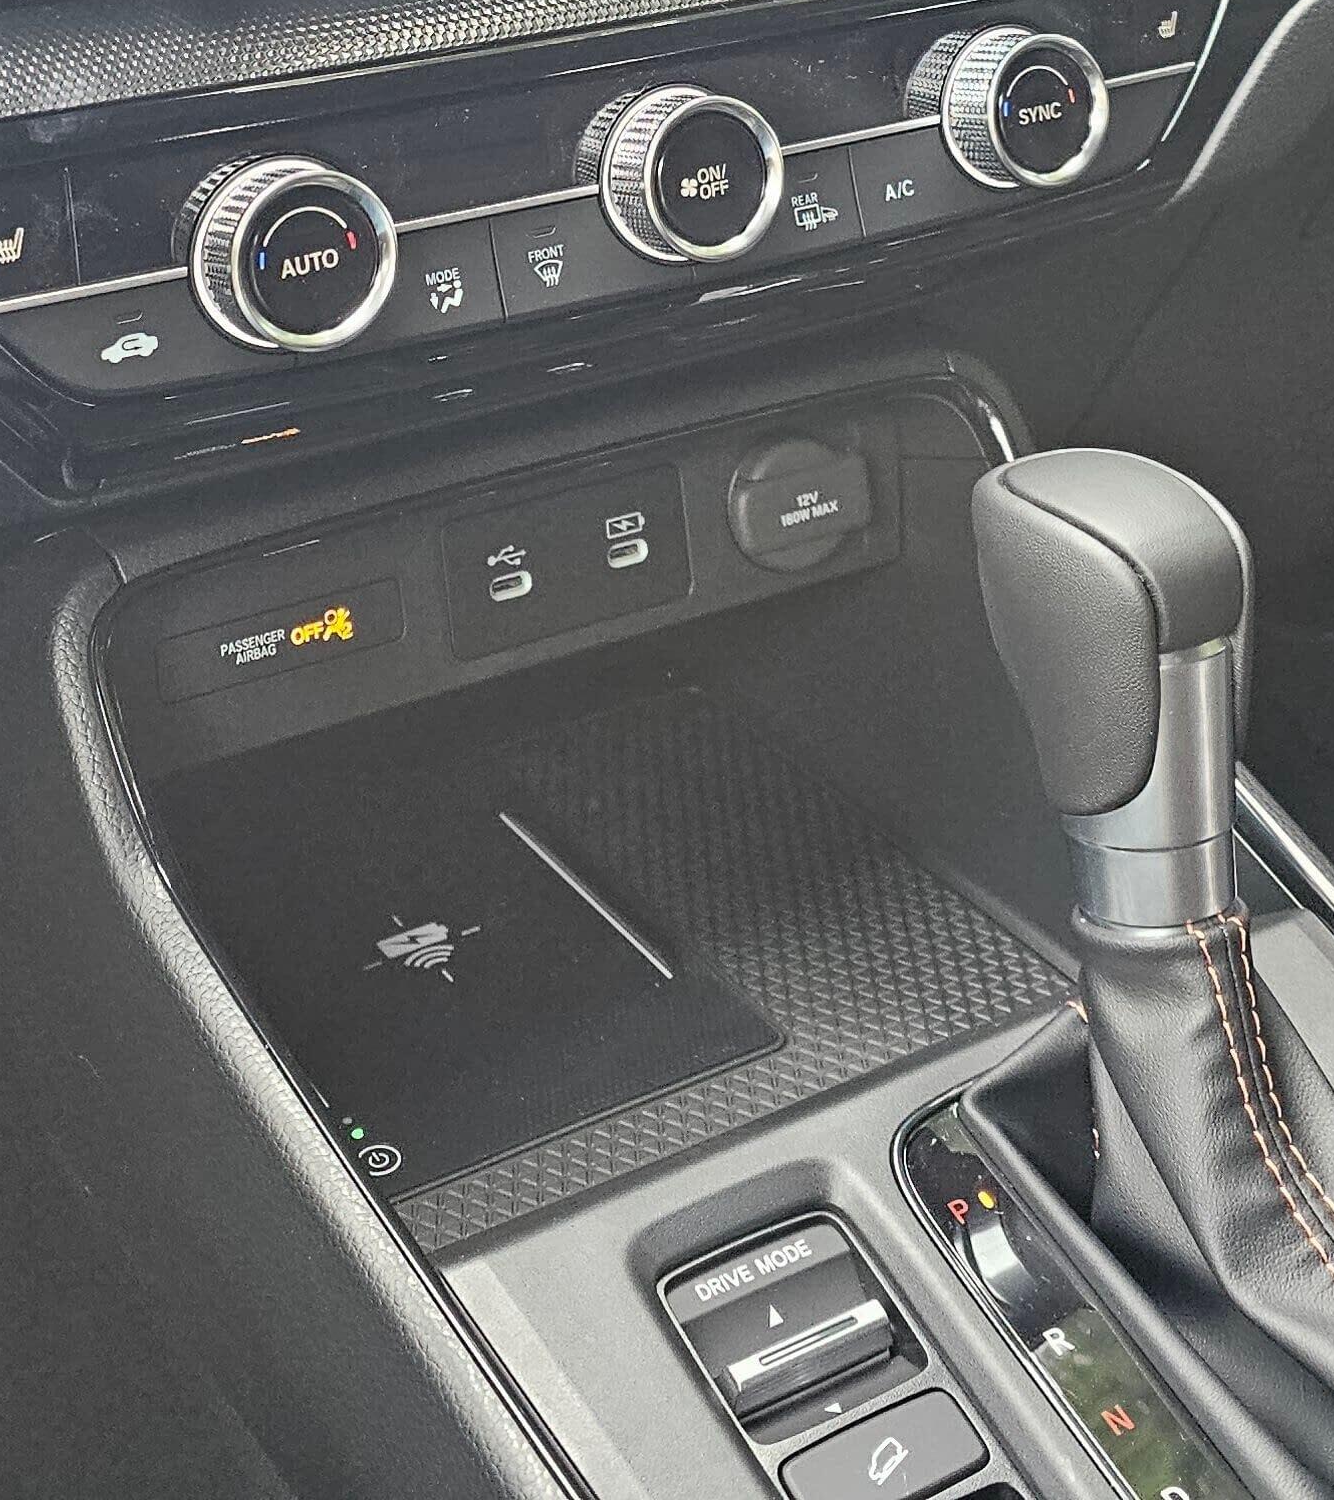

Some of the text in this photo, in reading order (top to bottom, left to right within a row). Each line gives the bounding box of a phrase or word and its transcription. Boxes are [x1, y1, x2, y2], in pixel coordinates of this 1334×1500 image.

[1018, 101, 1063, 127] SYNC
[696, 164, 727, 183] ON/
[699, 179, 730, 200] OFF
[791, 192, 819, 208] REAR
[885, 179, 916, 201] A/C
[280, 247, 340, 280] AUTO
[528, 243, 565, 264] FRONT
[425, 267, 461, 287] MODE
[796, 490, 819, 508] 12V
[811, 500, 839, 519] MAX
[220, 628, 286, 658] PASSENGER
[290, 621, 325, 646] OFF
[235, 643, 277, 666] AIRBAG
[946, 1199, 970, 1225] P
[695, 1238, 813, 1302] DRIVE MODE
[1042, 1327, 1077, 1356] R
[1100, 1403, 1137, 1436] N
